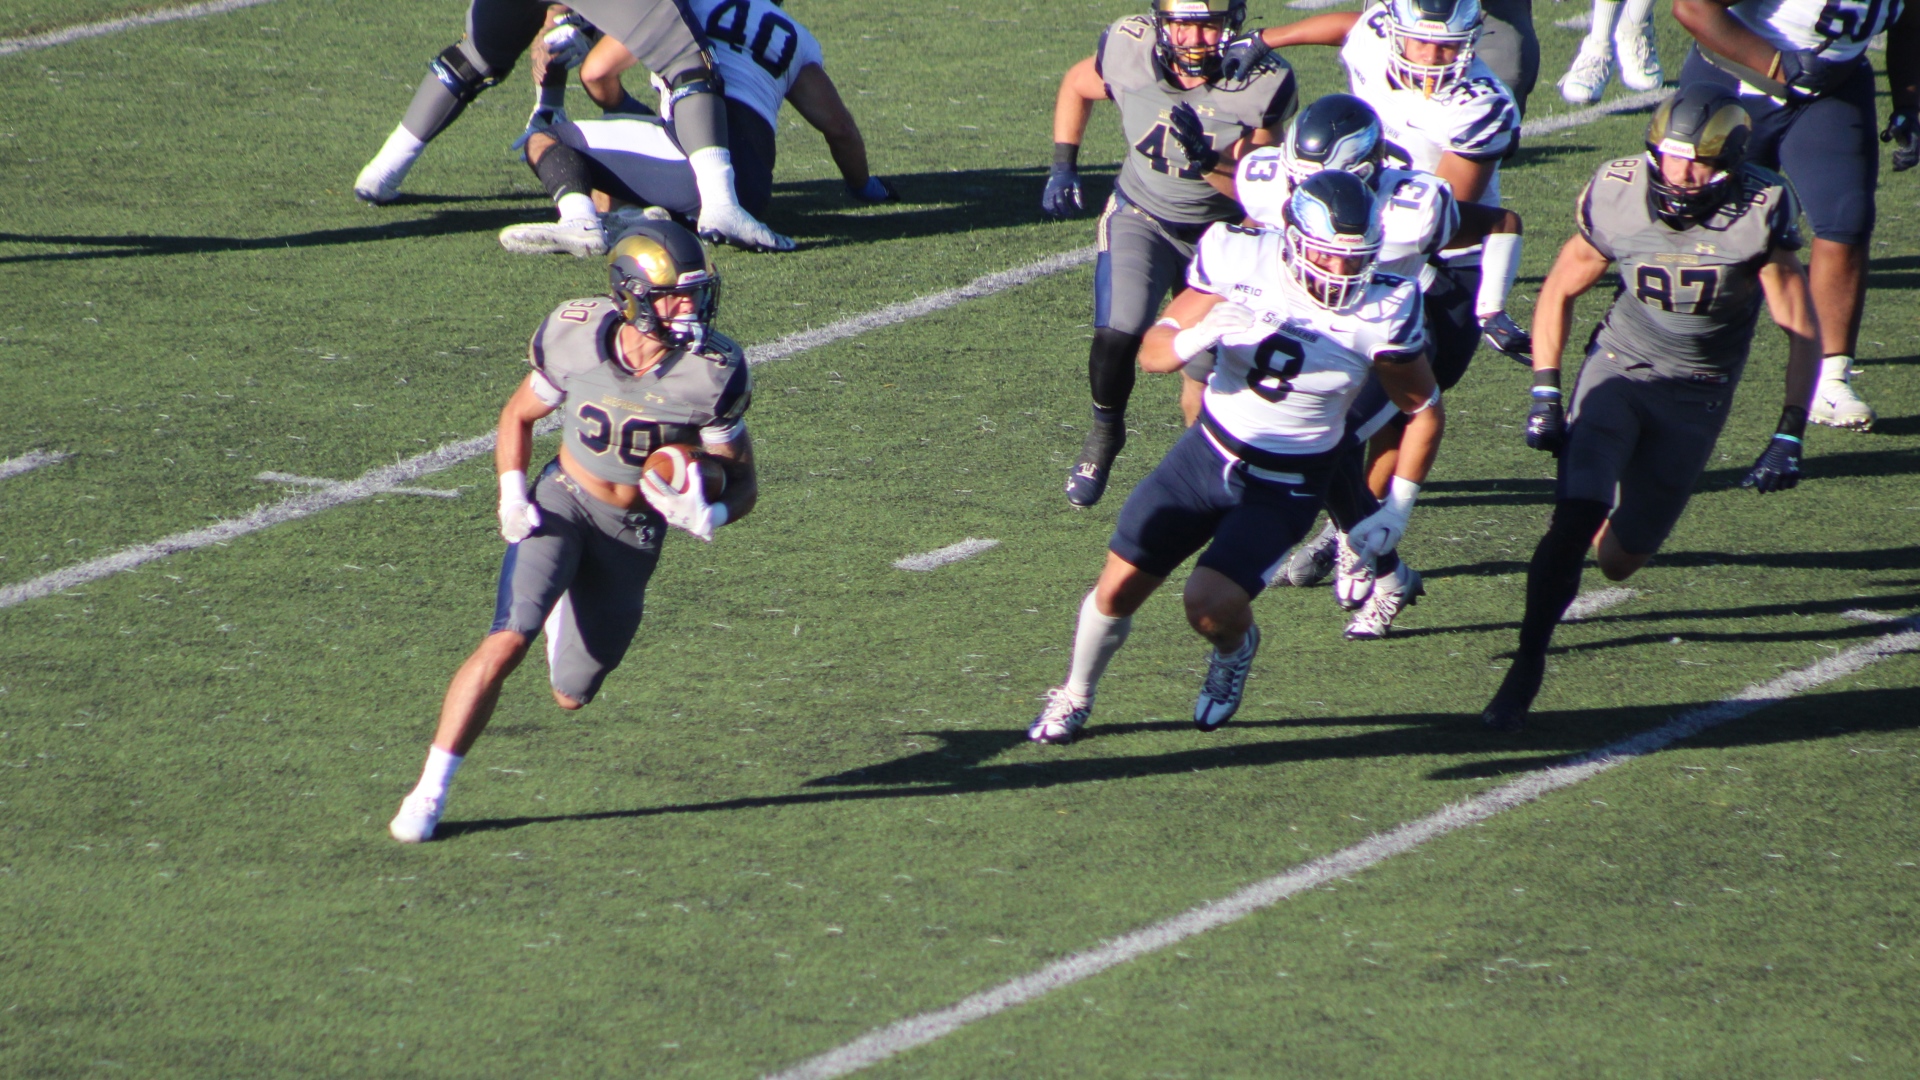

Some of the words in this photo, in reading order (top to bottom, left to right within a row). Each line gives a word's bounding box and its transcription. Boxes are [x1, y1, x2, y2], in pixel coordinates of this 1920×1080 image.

[706, 0, 798, 79] 40
[1117, 14, 1151, 42] 47
[1245, 153, 1281, 181] 13
[1604, 158, 1642, 185] 87
[1390, 178, 1429, 211] 13
[1635, 262, 1721, 316] 87
[558, 299, 598, 325] 30
[1247, 332, 1306, 403] 8
[575, 400, 665, 468] 30
